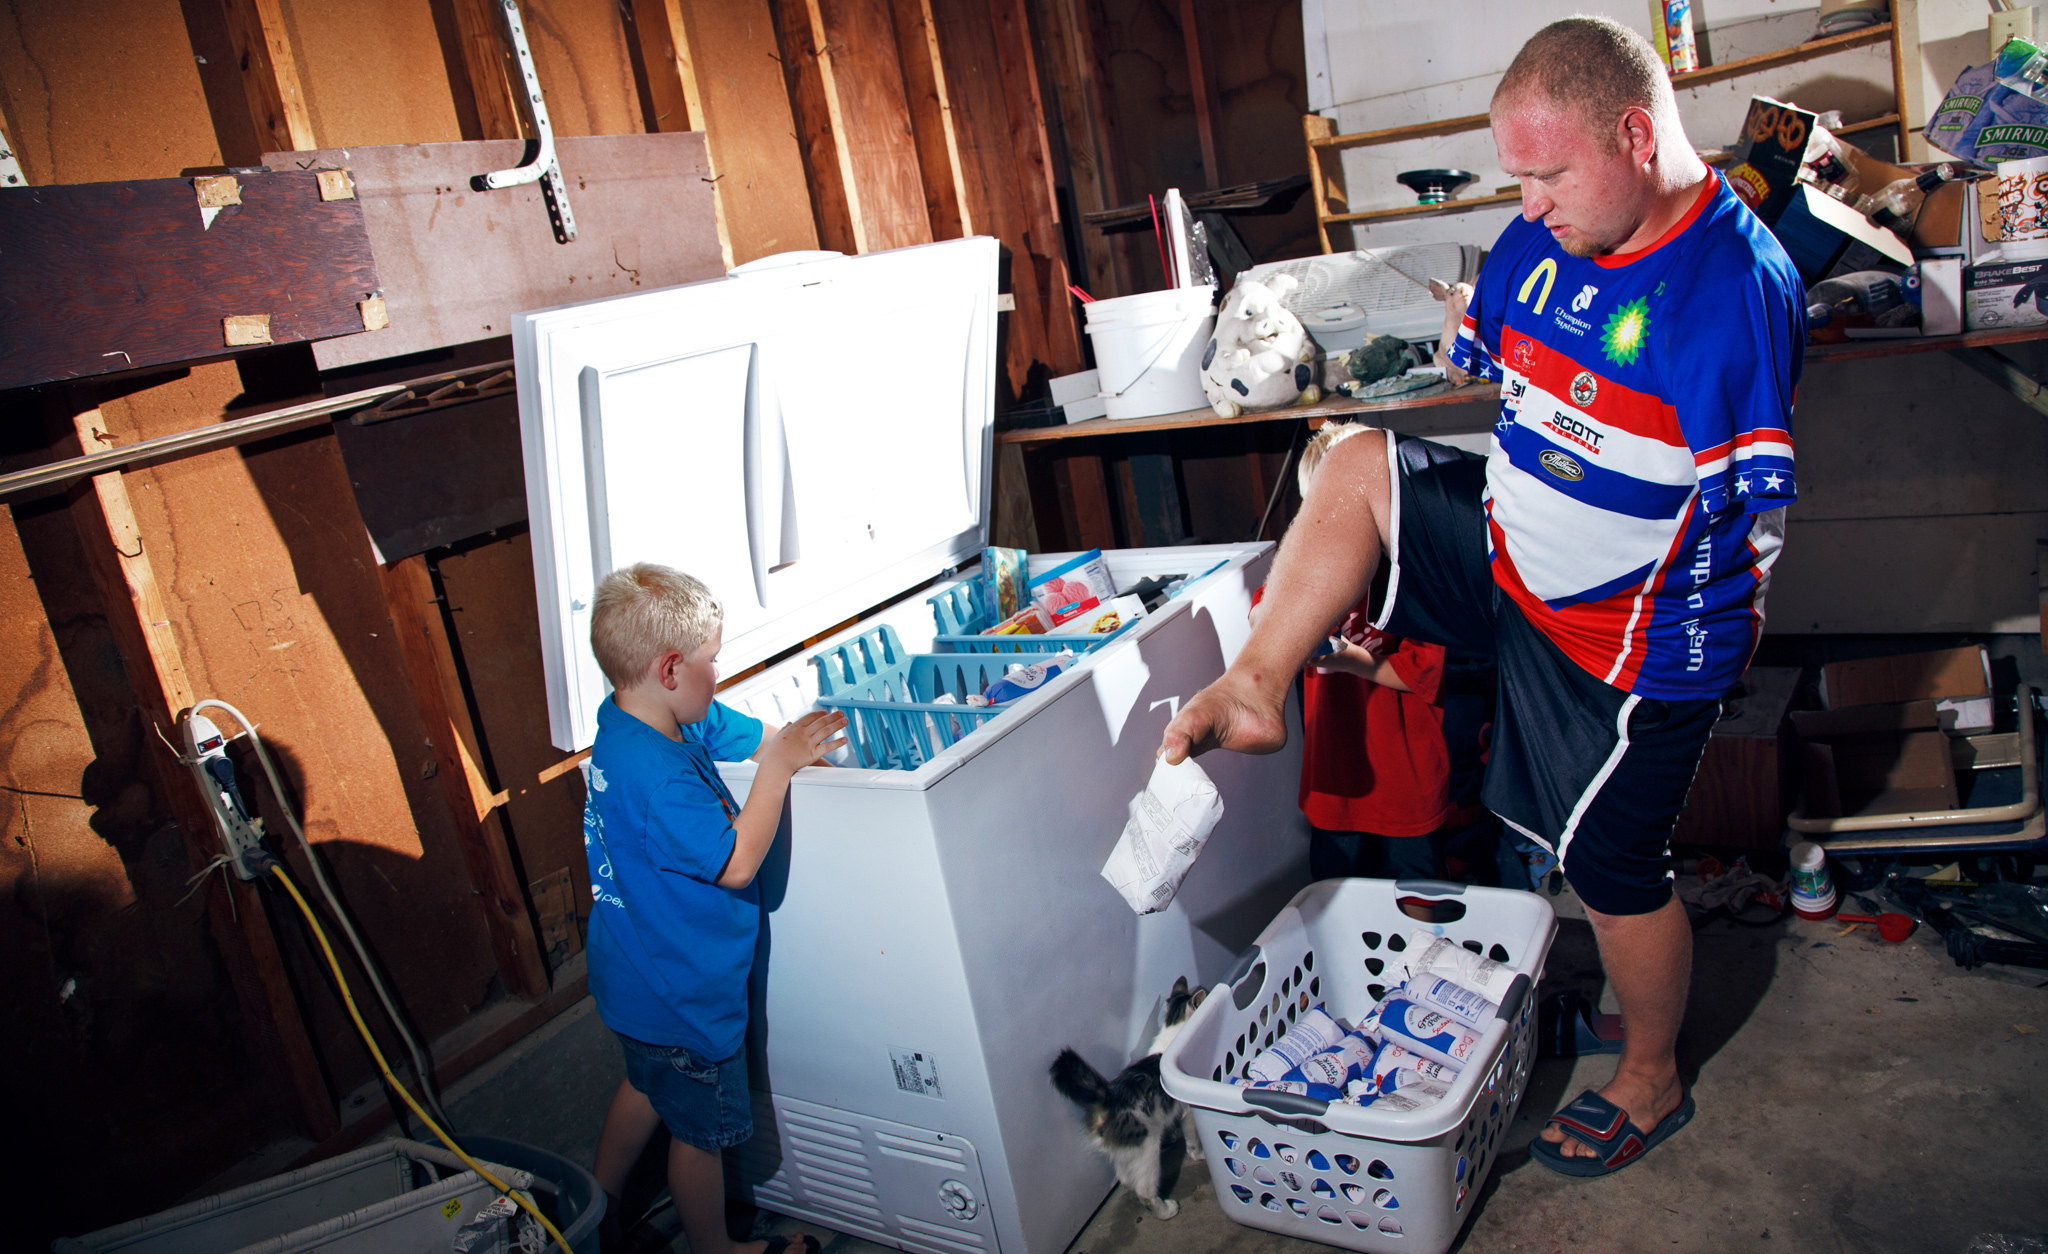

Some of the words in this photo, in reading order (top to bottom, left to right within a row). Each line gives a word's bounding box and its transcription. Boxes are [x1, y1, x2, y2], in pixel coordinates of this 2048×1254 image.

[2003, 146, 2027, 156] ICE
[1974, 264, 2043, 279] BRAKEBEST
[1554, 306, 1592, 331] Champion
[1554, 316, 1585, 337] System
[1552, 410, 1605, 446] SCOTT
[1314, 1058, 1338, 1085] Ground
[1322, 1056, 1339, 1077] Pork
